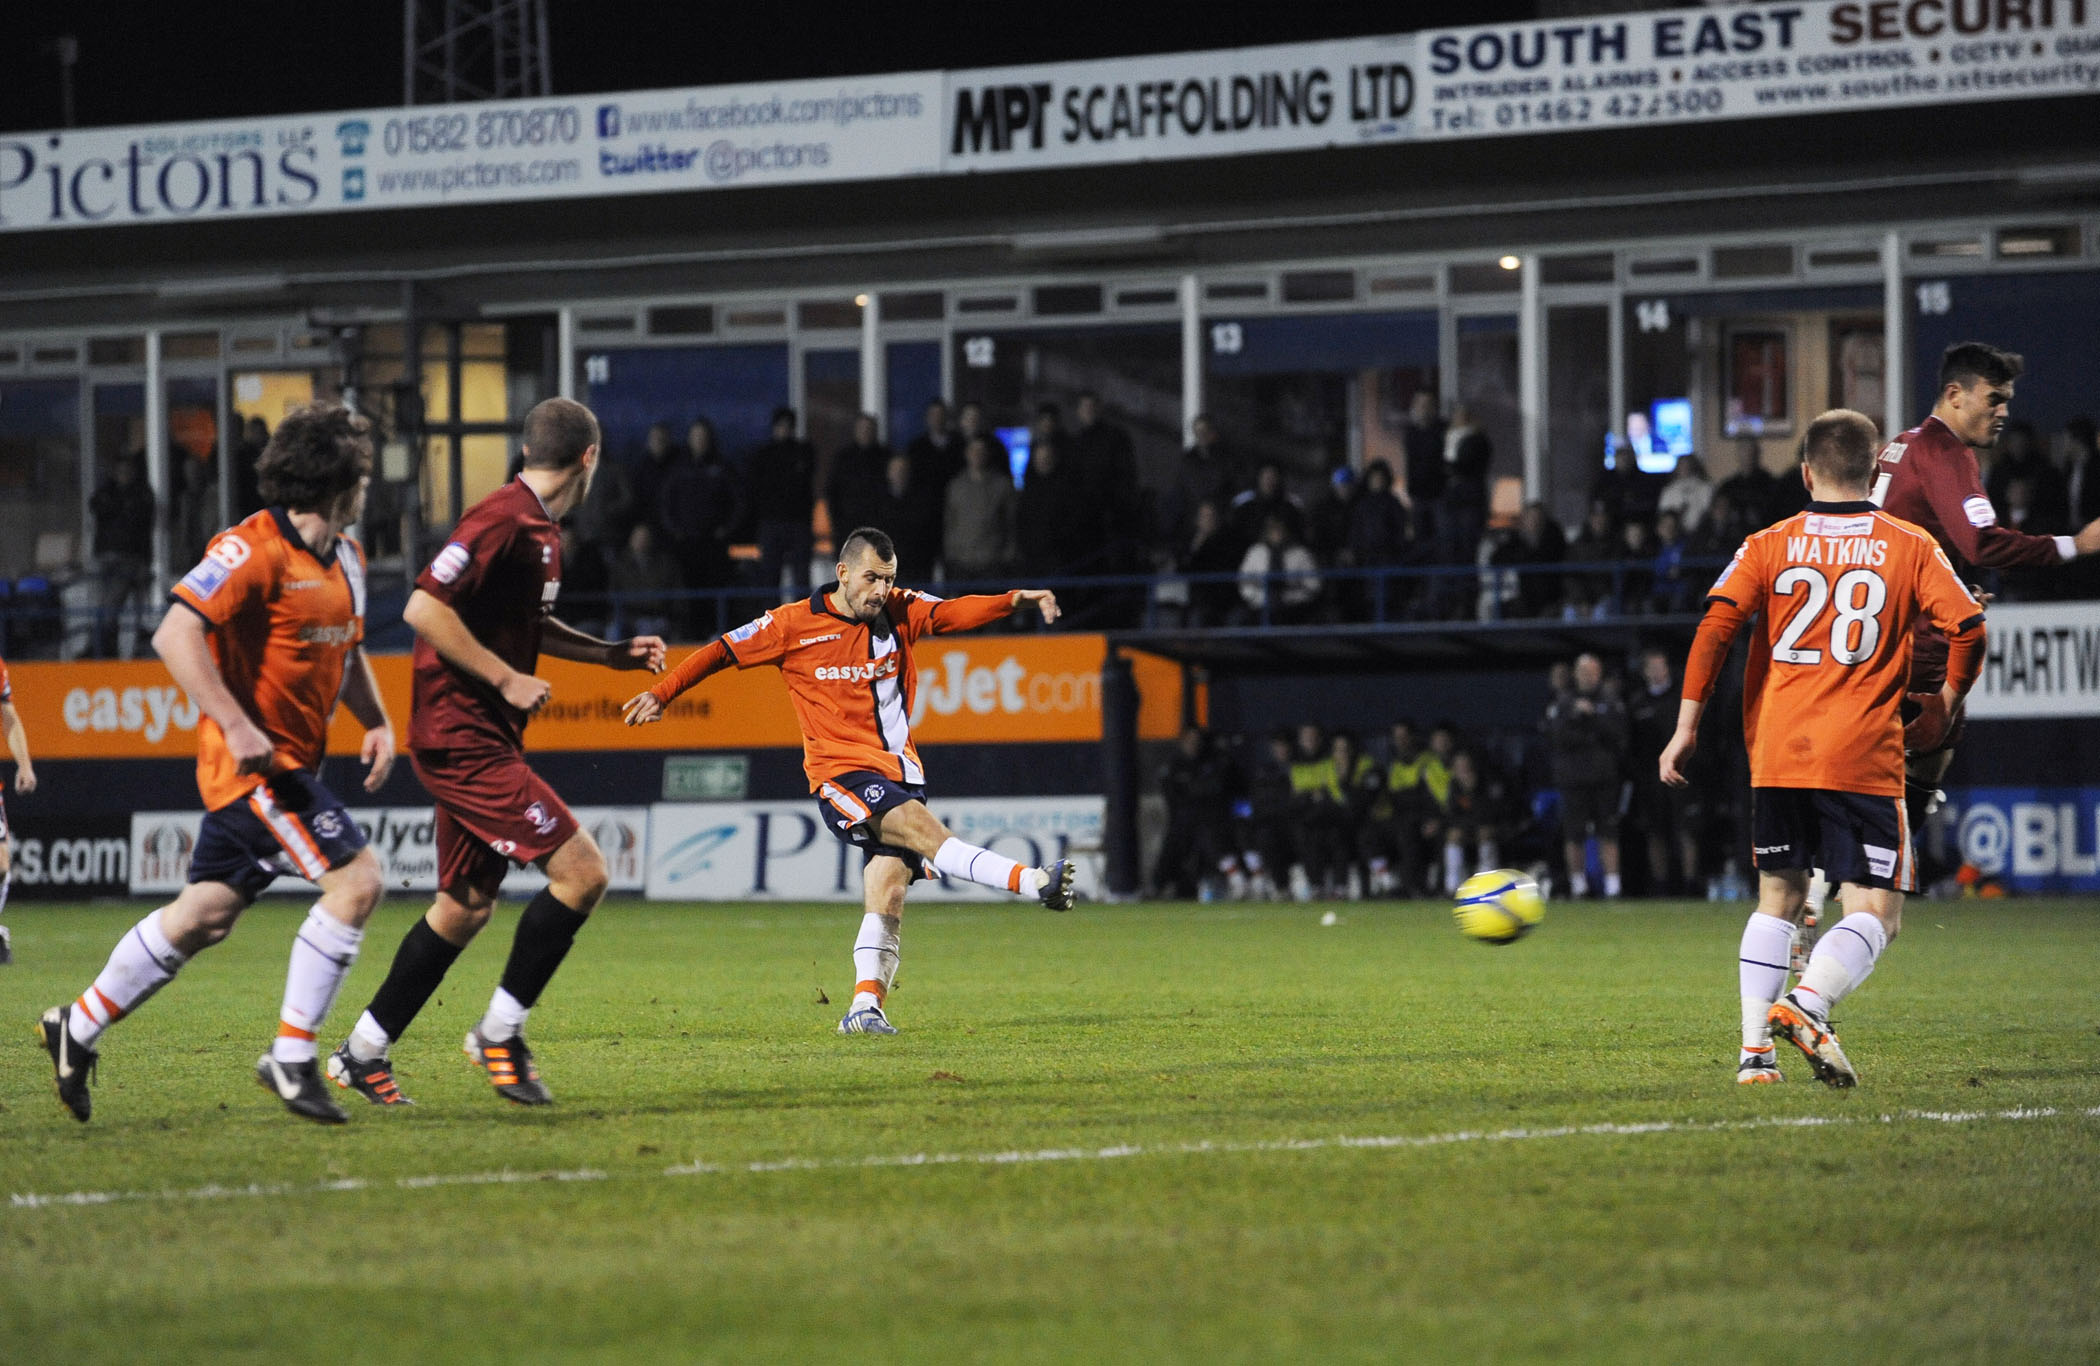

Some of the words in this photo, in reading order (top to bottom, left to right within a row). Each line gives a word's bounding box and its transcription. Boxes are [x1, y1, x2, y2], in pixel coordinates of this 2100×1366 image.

[1430, 23, 1627, 75] SOUTH
[1652, 9, 1802, 58] EAST
[1561, 68, 1659, 92] ALARMS
[1692, 58, 1787, 82] ACCESS
[1797, 49, 1914, 74] CONTROL
[1950, 40, 2021, 64] CCTV
[951, 82, 1053, 155] MPT
[1063, 68, 1333, 144] SCAFFOLDING
[1350, 63, 1415, 121] LTD
[1495, 99, 1592, 127] 01462
[383, 112, 470, 157] 01582
[475, 105, 581, 149] 870870
[377, 158, 582, 193] www.pictons.com
[599, 144, 699, 175] twitter
[1637, 301, 1668, 331] 14
[1787, 536, 1887, 566] WATKINS
[1773, 566, 1887, 665] 28
[815, 658, 896, 683] easyJet
